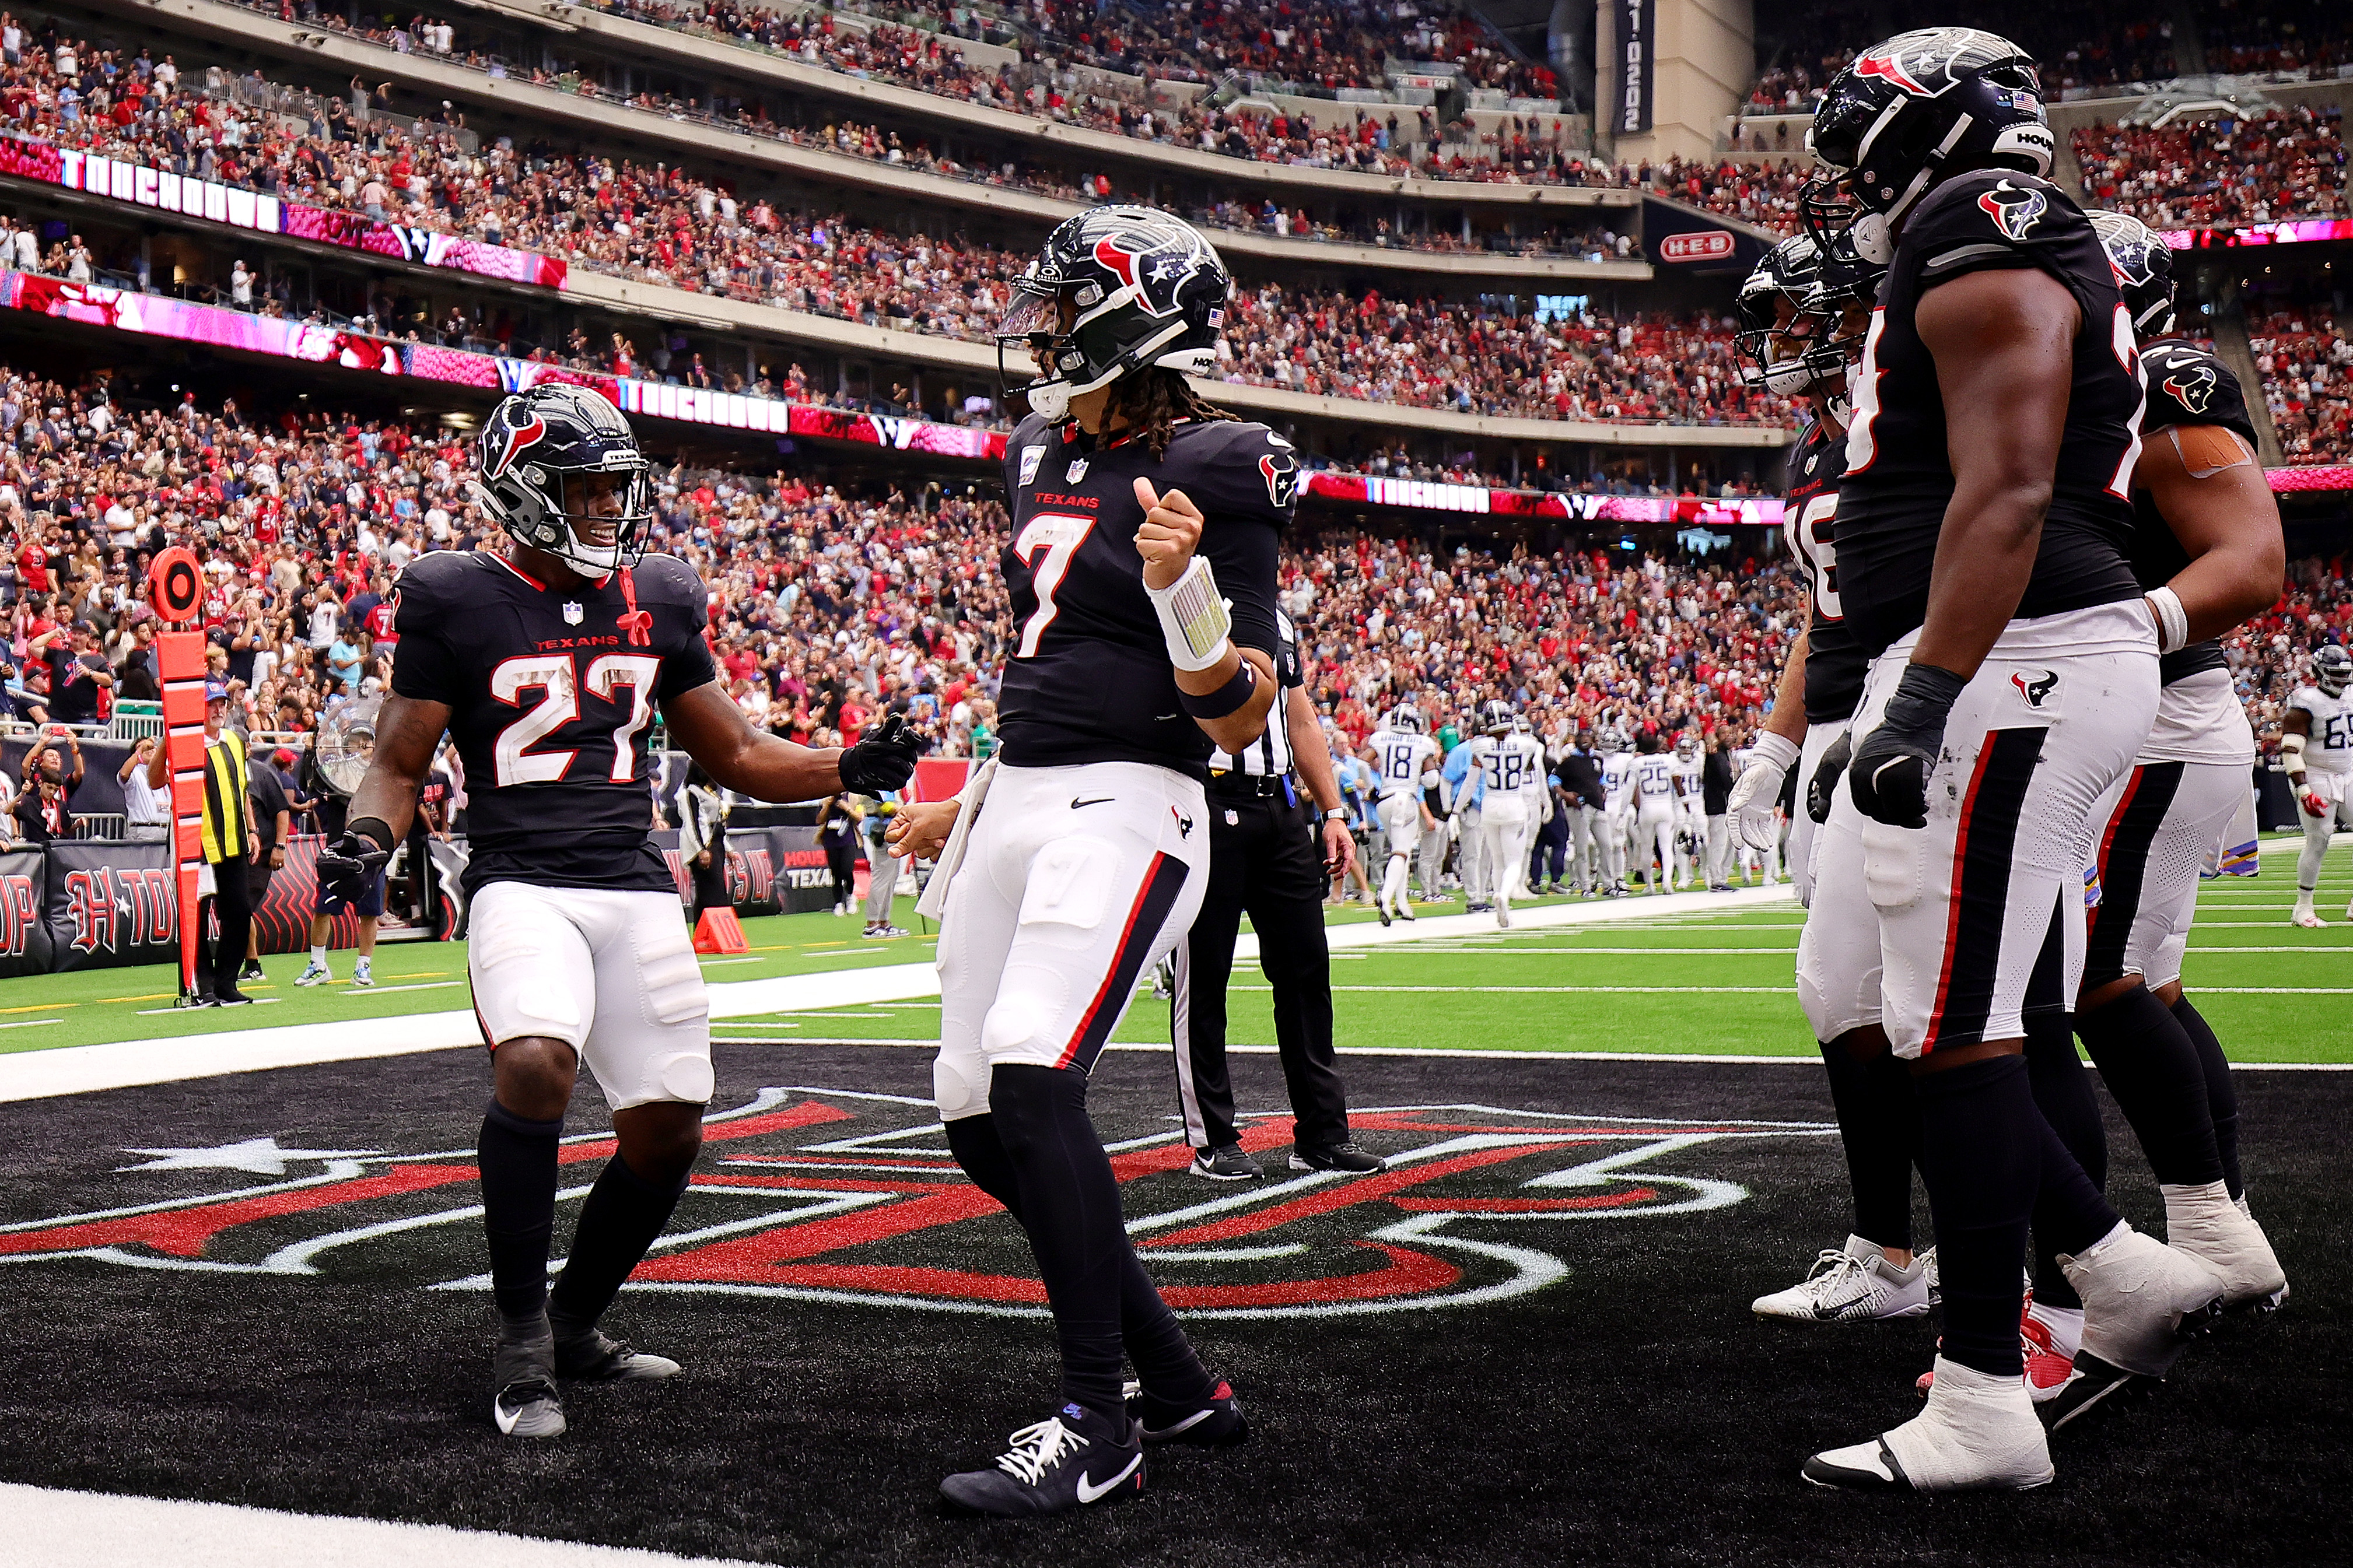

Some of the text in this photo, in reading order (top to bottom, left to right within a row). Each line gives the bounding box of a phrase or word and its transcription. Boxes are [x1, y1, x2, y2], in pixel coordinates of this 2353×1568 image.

[59, 148, 279, 233] TOUCHDOWN
[1035, 492, 1101, 509] TEXANS
[1013, 511, 1097, 658] 7
[533, 635, 619, 652] TEXANS
[490, 652, 664, 787] 27
[1385, 744, 1412, 778] 18
[1483, 754, 1522, 790] 38
[1640, 767, 1669, 794] 25
